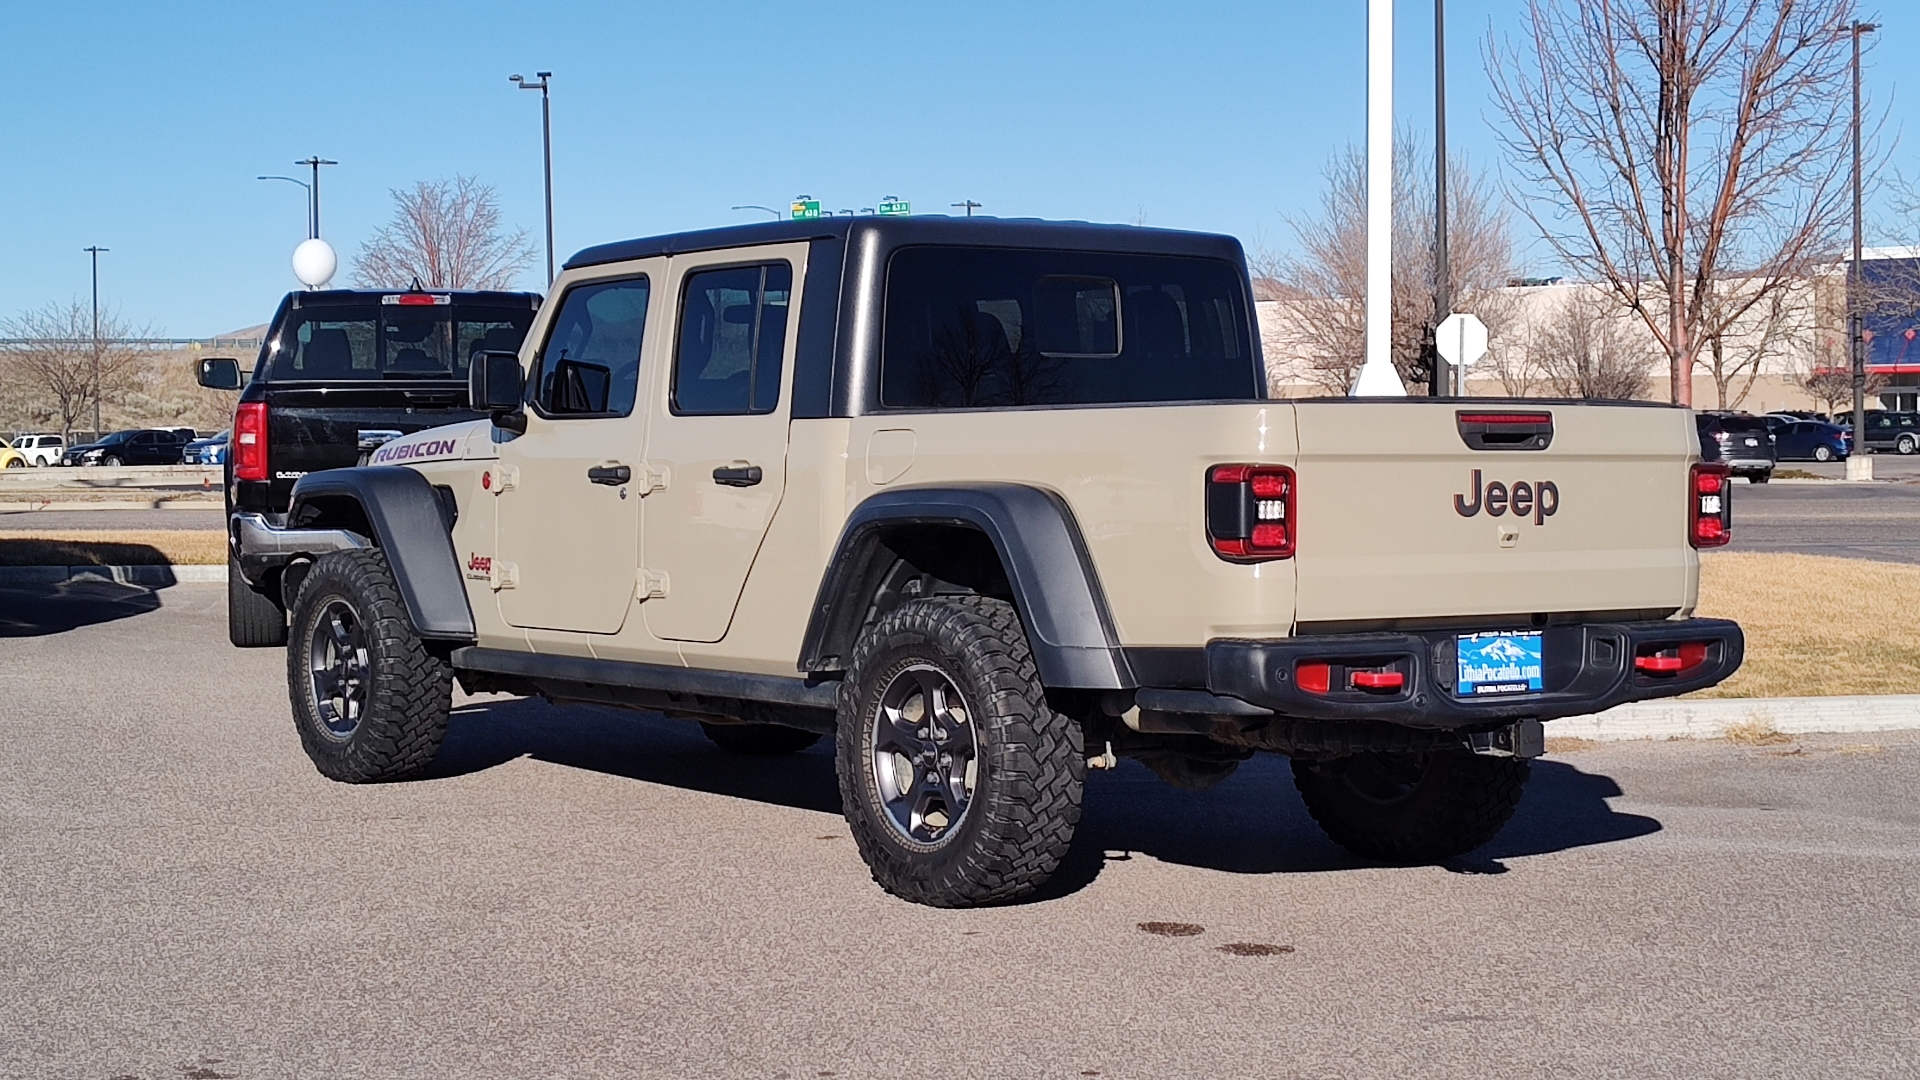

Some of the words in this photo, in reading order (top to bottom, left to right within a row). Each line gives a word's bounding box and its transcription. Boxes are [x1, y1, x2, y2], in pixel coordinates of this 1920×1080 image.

[374, 439, 457, 464] RUBICON
[1453, 468, 1559, 526] Jeep
[467, 551, 491, 575] Jeep
[1458, 662, 1540, 682] LithiaPocatello.com
